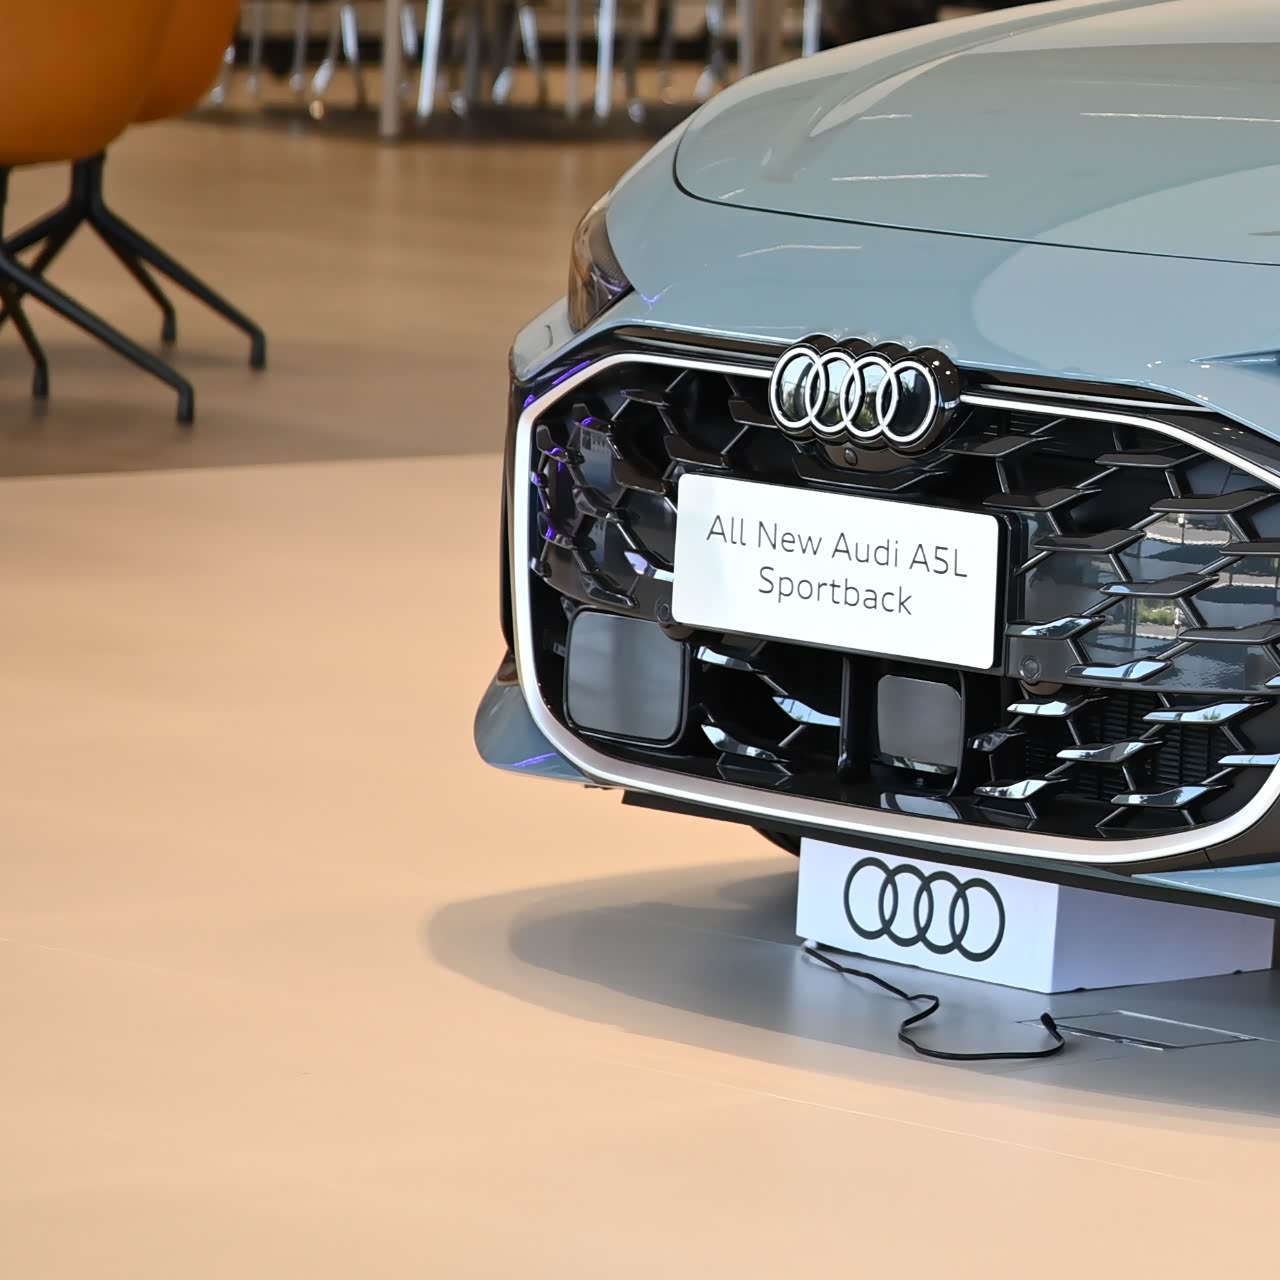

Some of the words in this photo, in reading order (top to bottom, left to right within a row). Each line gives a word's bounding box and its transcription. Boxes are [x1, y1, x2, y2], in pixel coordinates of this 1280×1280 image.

[706, 514, 747, 547] All
[757, 521, 822, 556] New
[831, 532, 899, 568] Audi
[909, 543, 968, 578] A5L
[757, 566, 912, 615] Sportback
